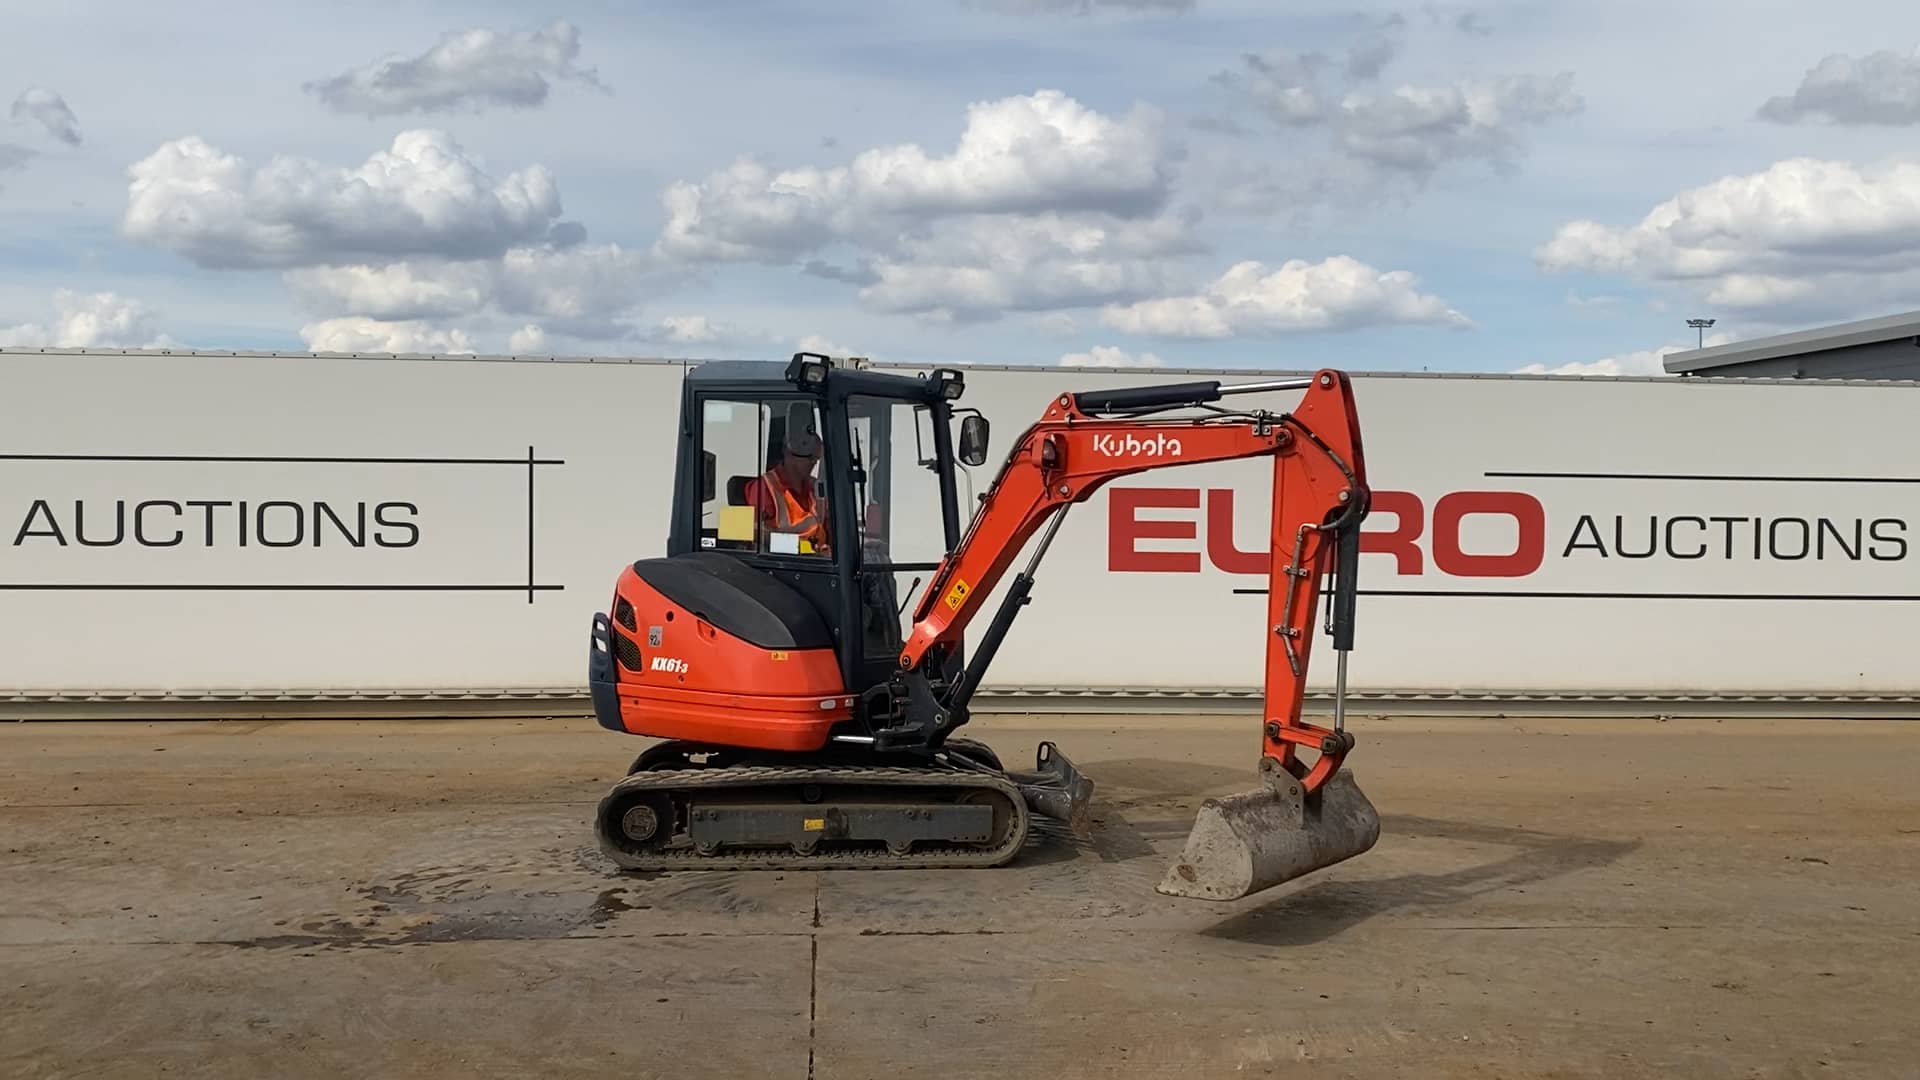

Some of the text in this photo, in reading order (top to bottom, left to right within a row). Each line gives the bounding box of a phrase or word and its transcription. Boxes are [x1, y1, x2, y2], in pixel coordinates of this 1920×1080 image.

[1093, 433, 1181, 457] Kubota
[13, 500, 420, 547] AUCTIONS
[1563, 514, 1908, 561] AUCTIONS
[651, 656, 688, 673] KX61-3
